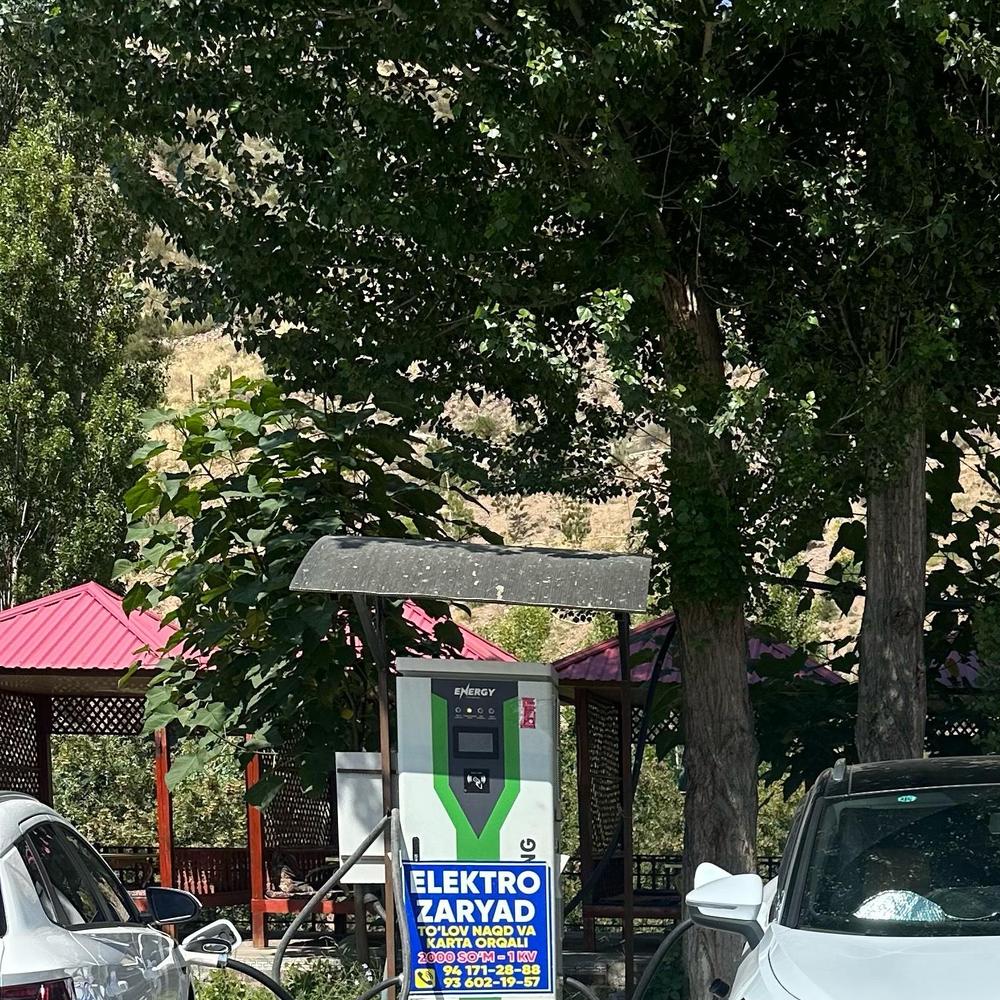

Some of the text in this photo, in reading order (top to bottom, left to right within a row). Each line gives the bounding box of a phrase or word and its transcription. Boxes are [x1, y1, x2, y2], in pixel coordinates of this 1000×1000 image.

[454, 684, 496, 698] ENERGY
[410, 870, 541, 894] ELEKTRO
[417, 899, 536, 923] ZARYAD
[472, 925, 514, 936] NAQD
[516, 925, 536, 936] VA
[427, 937, 528, 949] KARTA ORQALI
[417, 951, 455, 964] 2000
[507, 951, 515, 963] 1
[517, 951, 538, 963] KV
[442, 964, 541, 976] 94 171-28-88
[442, 976, 541, 988] 93 602-19-57
